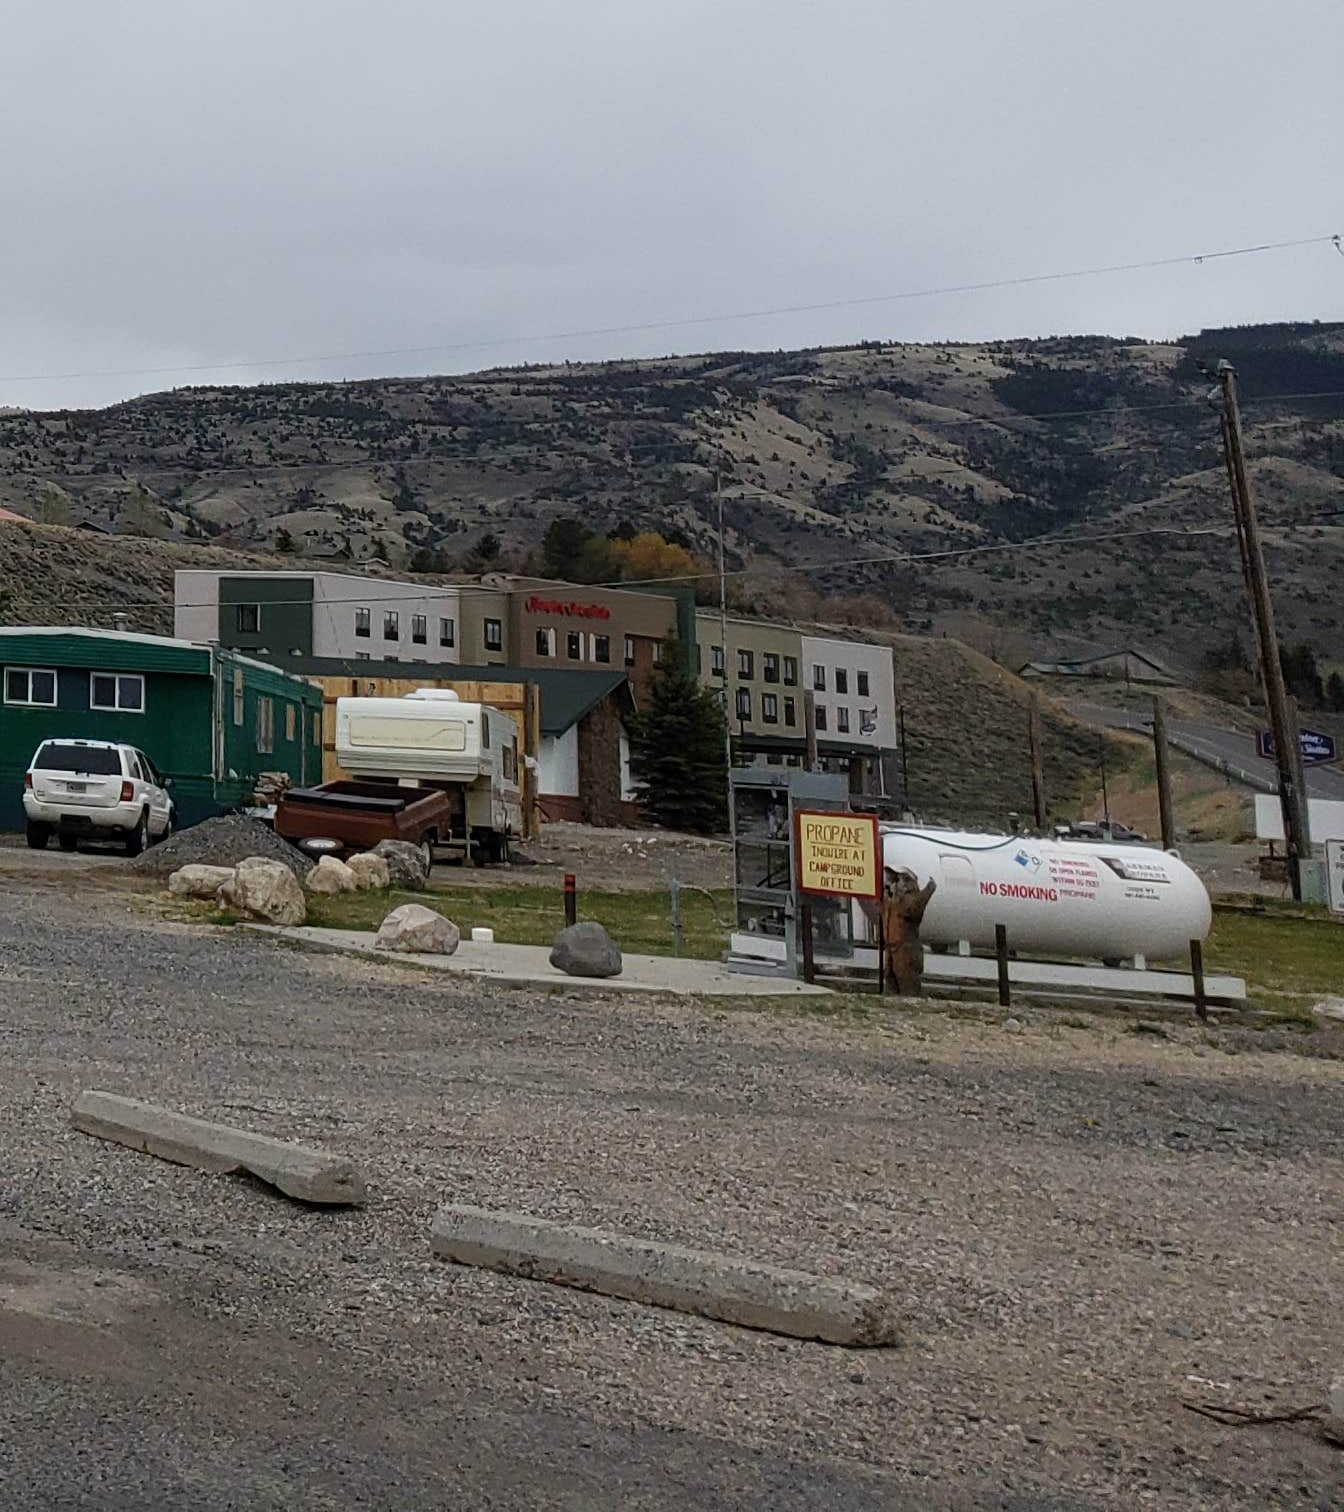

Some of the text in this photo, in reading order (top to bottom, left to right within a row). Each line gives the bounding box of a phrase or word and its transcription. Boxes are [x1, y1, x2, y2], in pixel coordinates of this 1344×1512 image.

[806, 823, 864, 845] PROPANE
[809, 860, 865, 877] CAMPGROUND
[820, 876, 854, 890] OFFICE
[979, 882, 1058, 902] NO SMOKING
